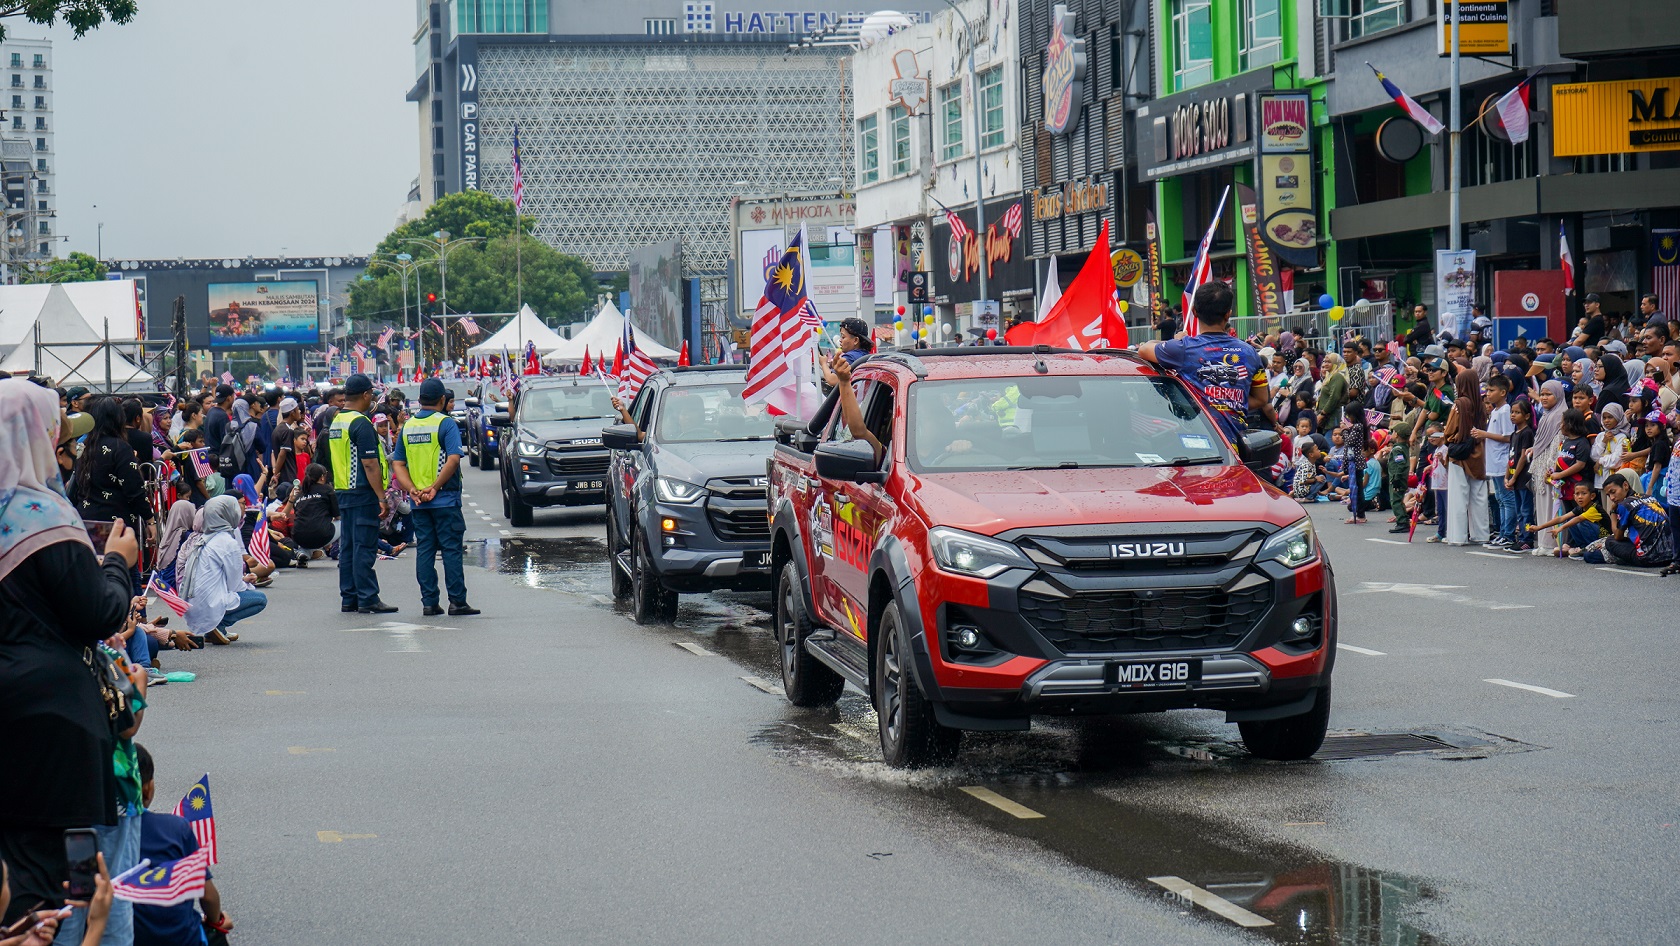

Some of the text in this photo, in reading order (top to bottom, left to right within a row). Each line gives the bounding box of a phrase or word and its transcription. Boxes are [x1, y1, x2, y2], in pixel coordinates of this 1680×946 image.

[725, 12, 838, 33] HATTEN
[1444, 13, 1508, 22] Pistani Cuisine
[1555, 87, 1588, 96] RESTORAN
[464, 104, 476, 118] P
[1264, 100, 1307, 132] AYAM BAKAR
[1203, 97, 1229, 152] SOLO
[464, 123, 477, 191] CAR PARK
[1033, 176, 1109, 221] Texas Chicken
[1113, 262, 1140, 278] Texas
[1150, 242, 1160, 287] WONG
[1151, 292, 1161, 316] SOL
[1508, 340, 1537, 349] PZA
[834, 518, 873, 575] ISUZU
[1111, 542, 1185, 558] ISUZU
[1118, 662, 1189, 682] MDX 618
